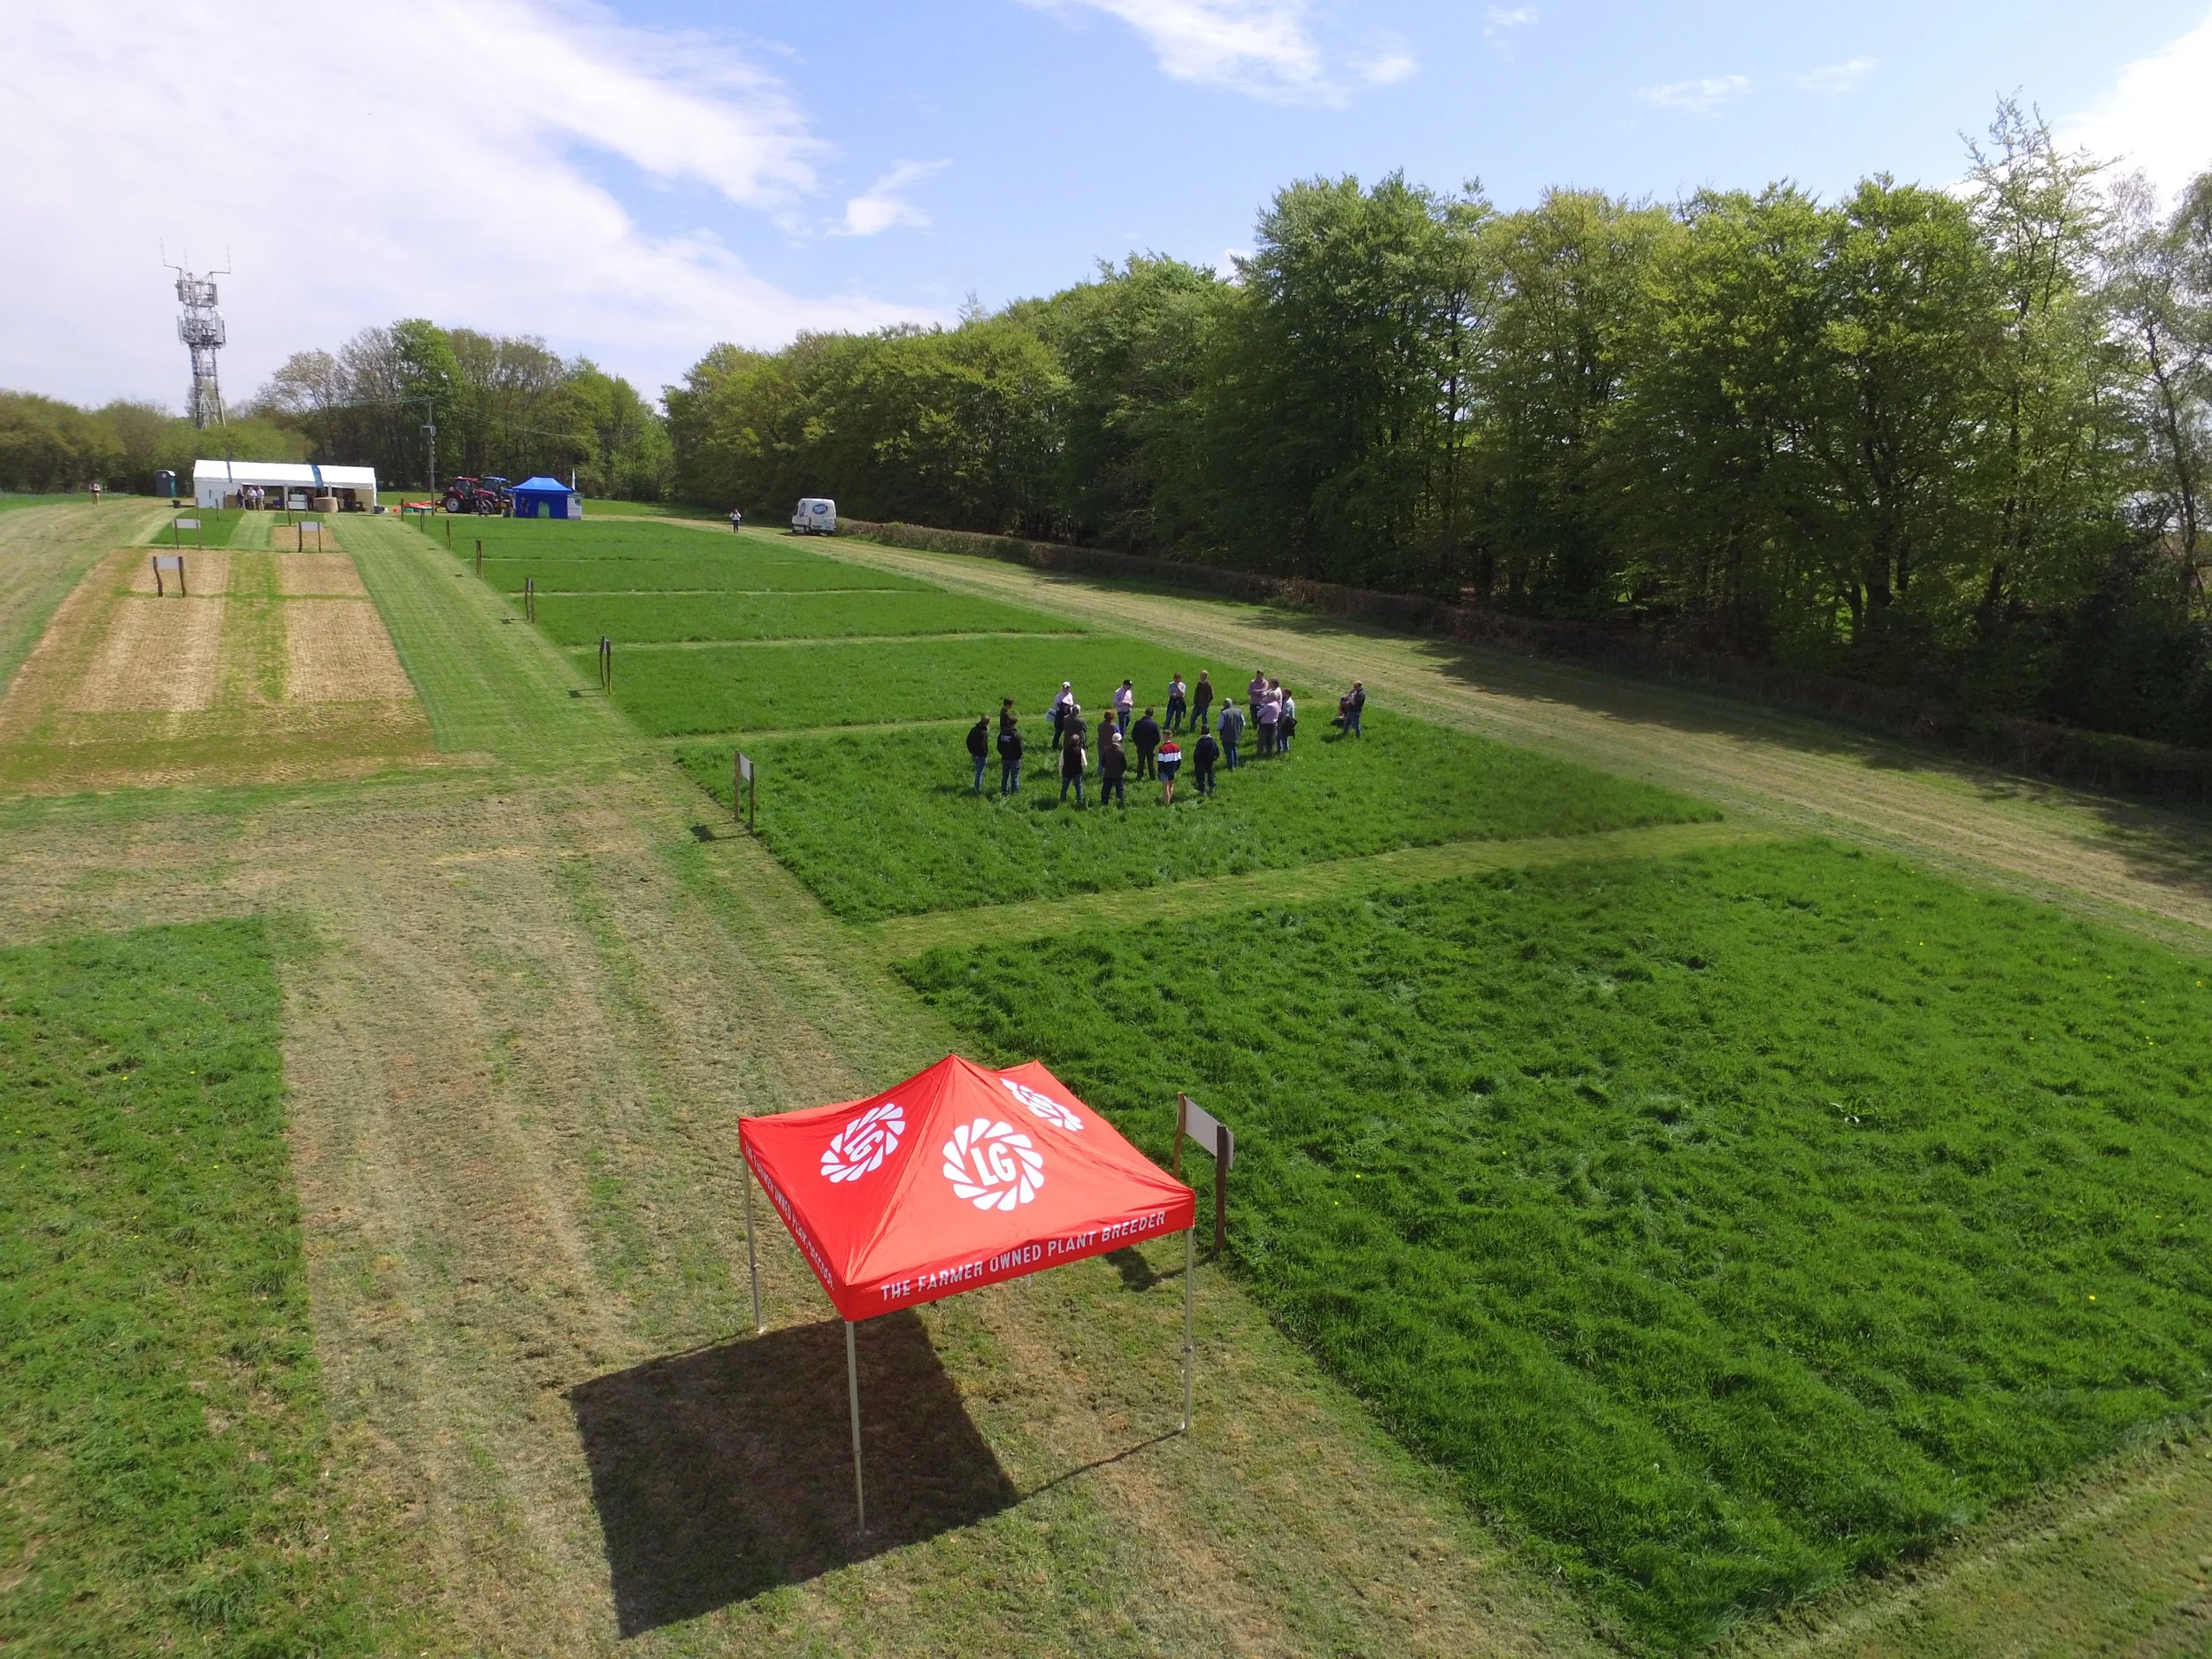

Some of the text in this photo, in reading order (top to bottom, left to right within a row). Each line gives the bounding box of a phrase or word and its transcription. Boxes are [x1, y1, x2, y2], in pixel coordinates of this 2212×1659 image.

[843, 1122, 884, 1163] LG
[970, 1142, 1017, 1187] LG
[880, 1210, 1165, 1302] THE FARMER OWNED PLANT BREEDER
